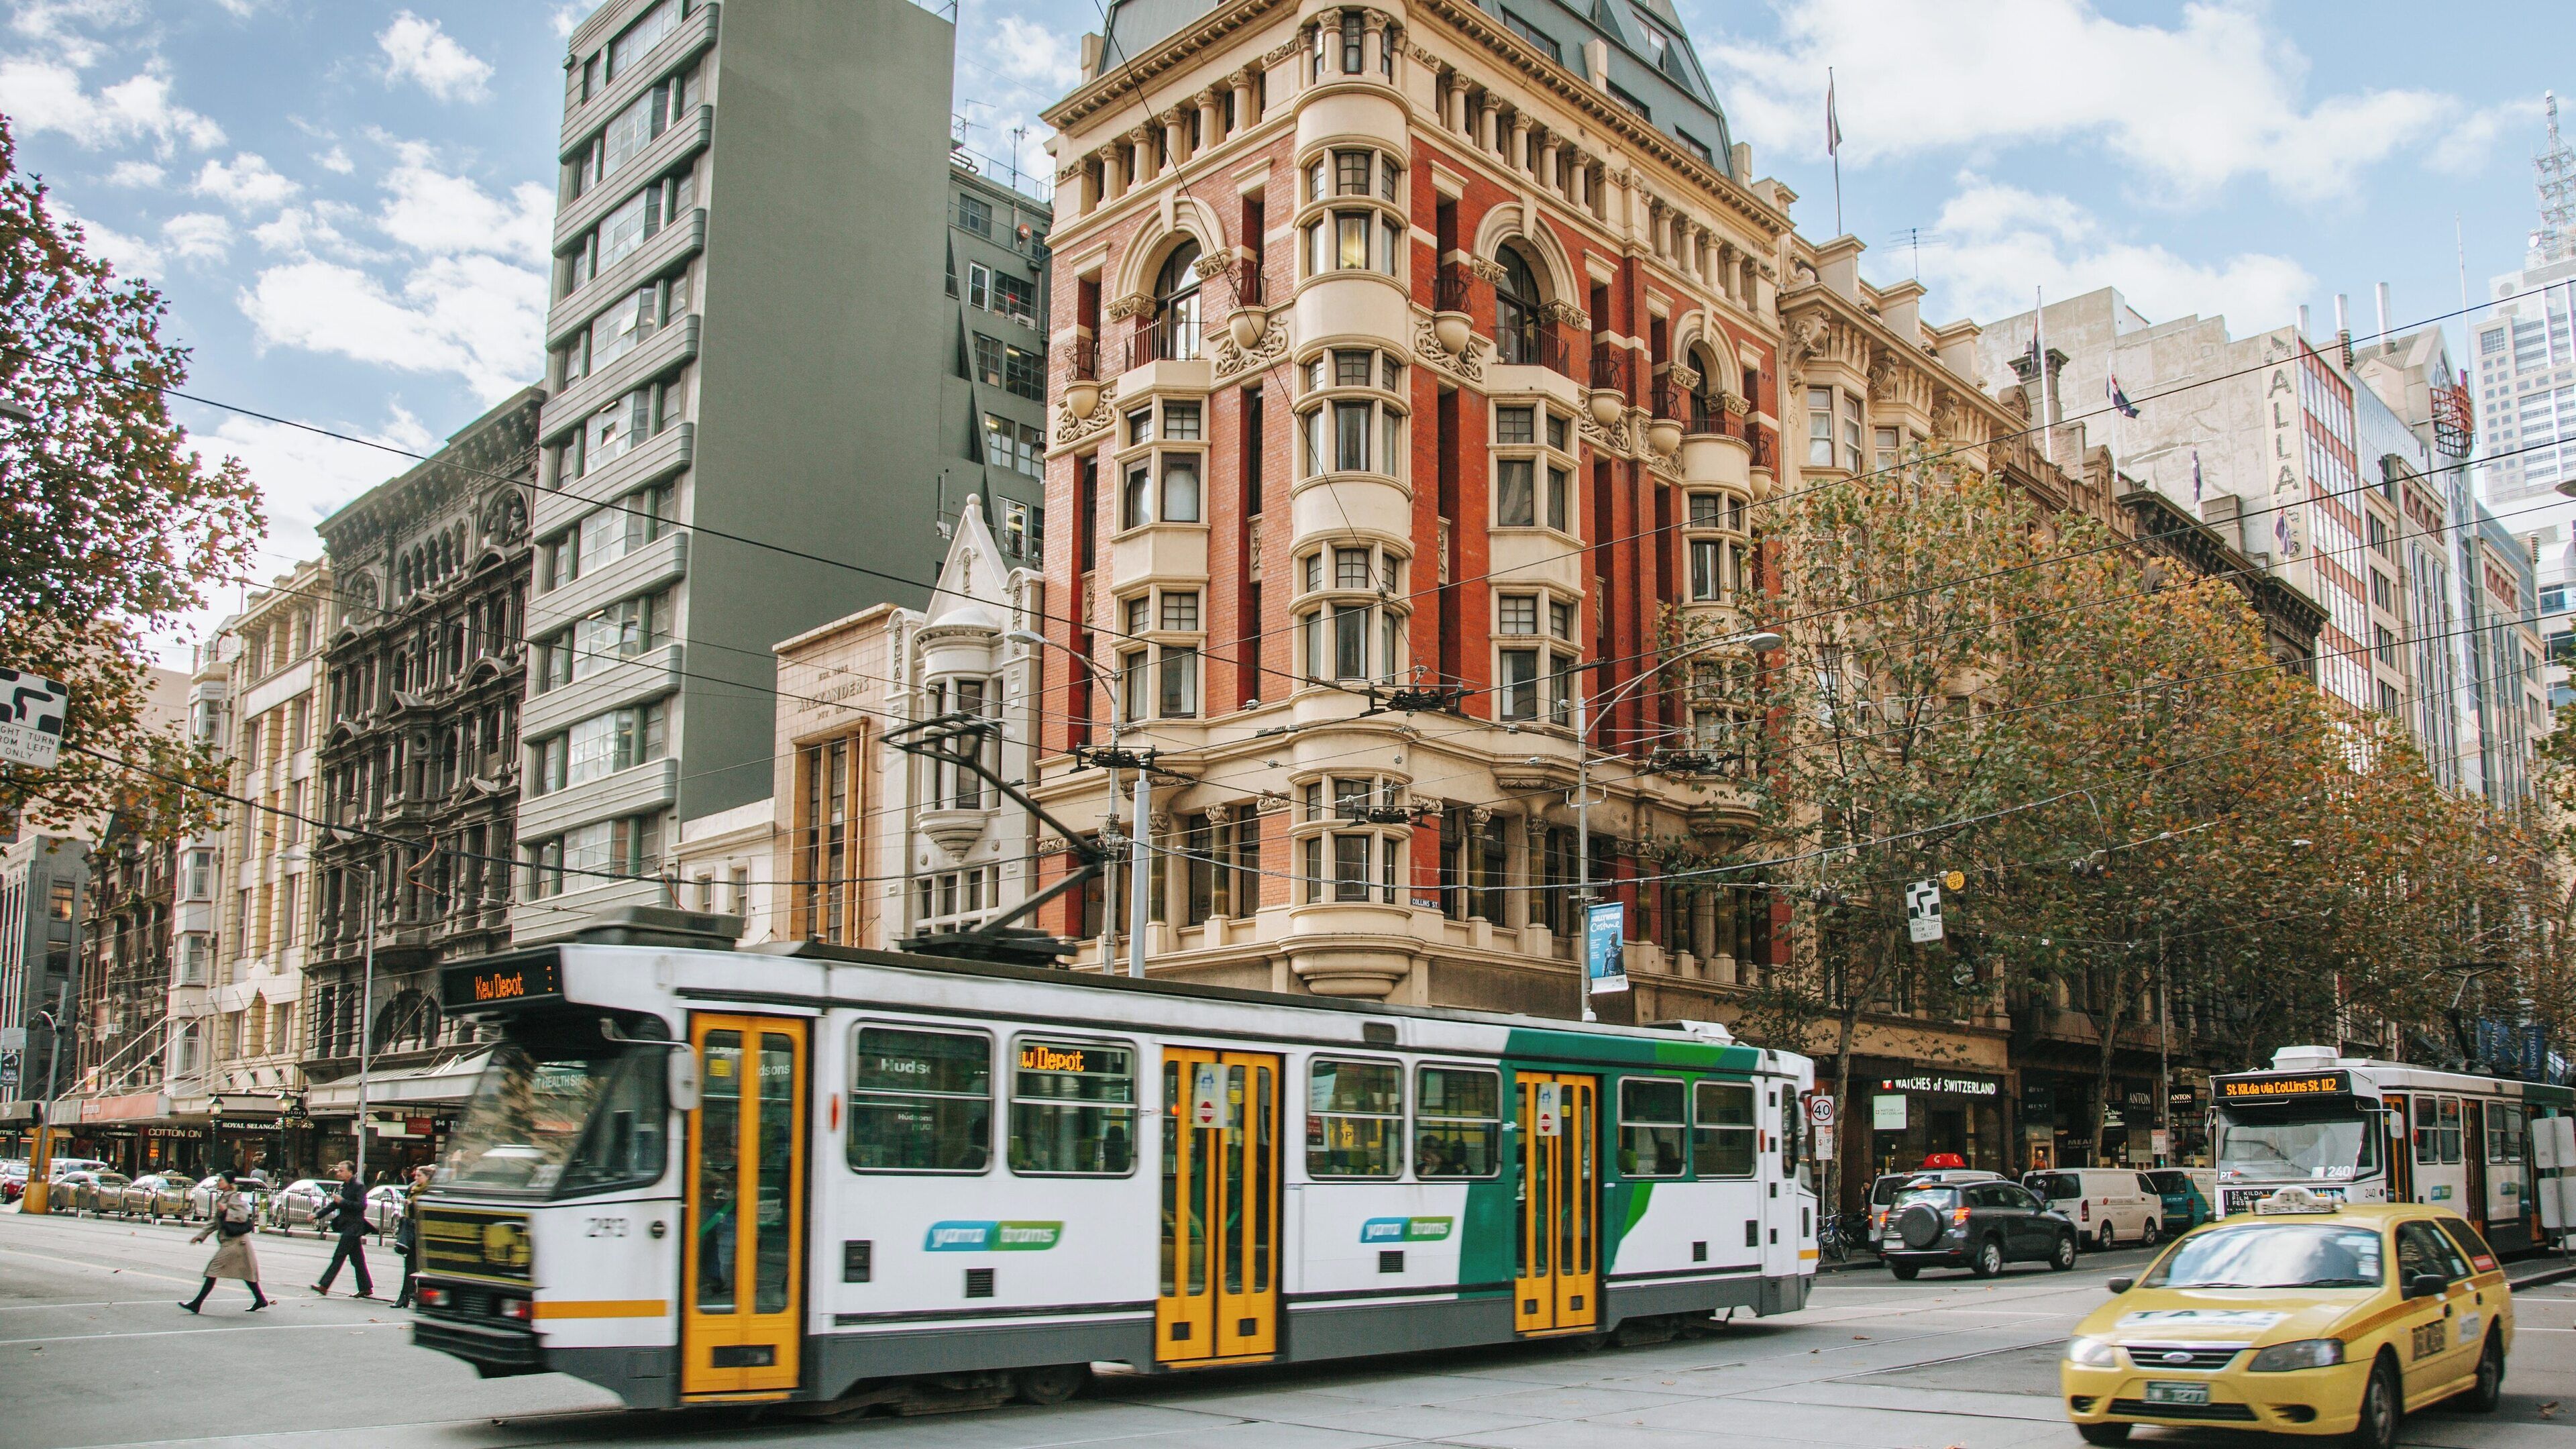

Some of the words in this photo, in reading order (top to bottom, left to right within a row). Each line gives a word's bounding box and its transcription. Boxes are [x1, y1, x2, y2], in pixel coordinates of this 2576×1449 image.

[798, 678, 869, 713] ALEXANDERS
[1, 726, 20, 736] GHT
[29, 732, 55, 745] TURN
[6, 747, 34, 759] ONLY
[28, 743, 52, 754] LEFT
[2486, 855, 2498, 864] 29
[1950, 879, 1962, 888] OFF
[1412, 898, 1430, 907] COLLINS
[1591, 912, 1621, 922] HOLLYWOOD
[1591, 921, 1621, 932] Costume
[475, 975, 494, 1000] Kew
[494, 972, 523, 998] Depot
[1038, 1046, 1085, 1072] Depot
[759, 1064, 790, 1077] dsons
[542, 1075, 570, 1088] HEALTH
[1895, 1077, 1931, 1090] WATCHES
[1933, 1078, 1941, 1091] of
[1944, 1079, 1996, 1095] SWITZERLAND
[2226, 1083, 2237, 1095] St
[2238, 1082, 2259, 1095] Kilda
[2261, 1082, 2274, 1094] via
[2275, 1081, 2307, 1093] Collins
[2308, 1079, 2319, 1091] St
[2321, 1078, 2337, 1091] 112
[2129, 1092, 2151, 1105] ANTON
[1814, 1105, 1830, 1115] 40
[148, 1128, 185, 1138] COTTON
[188, 1130, 202, 1138] ON
[2220, 1171, 2233, 1179] PT
[2327, 1165, 2351, 1177] 240
[2365, 1189, 2375, 1198] 240
[1000, 1225, 1056, 1242] trams
[1411, 1220, 1448, 1235] trams
